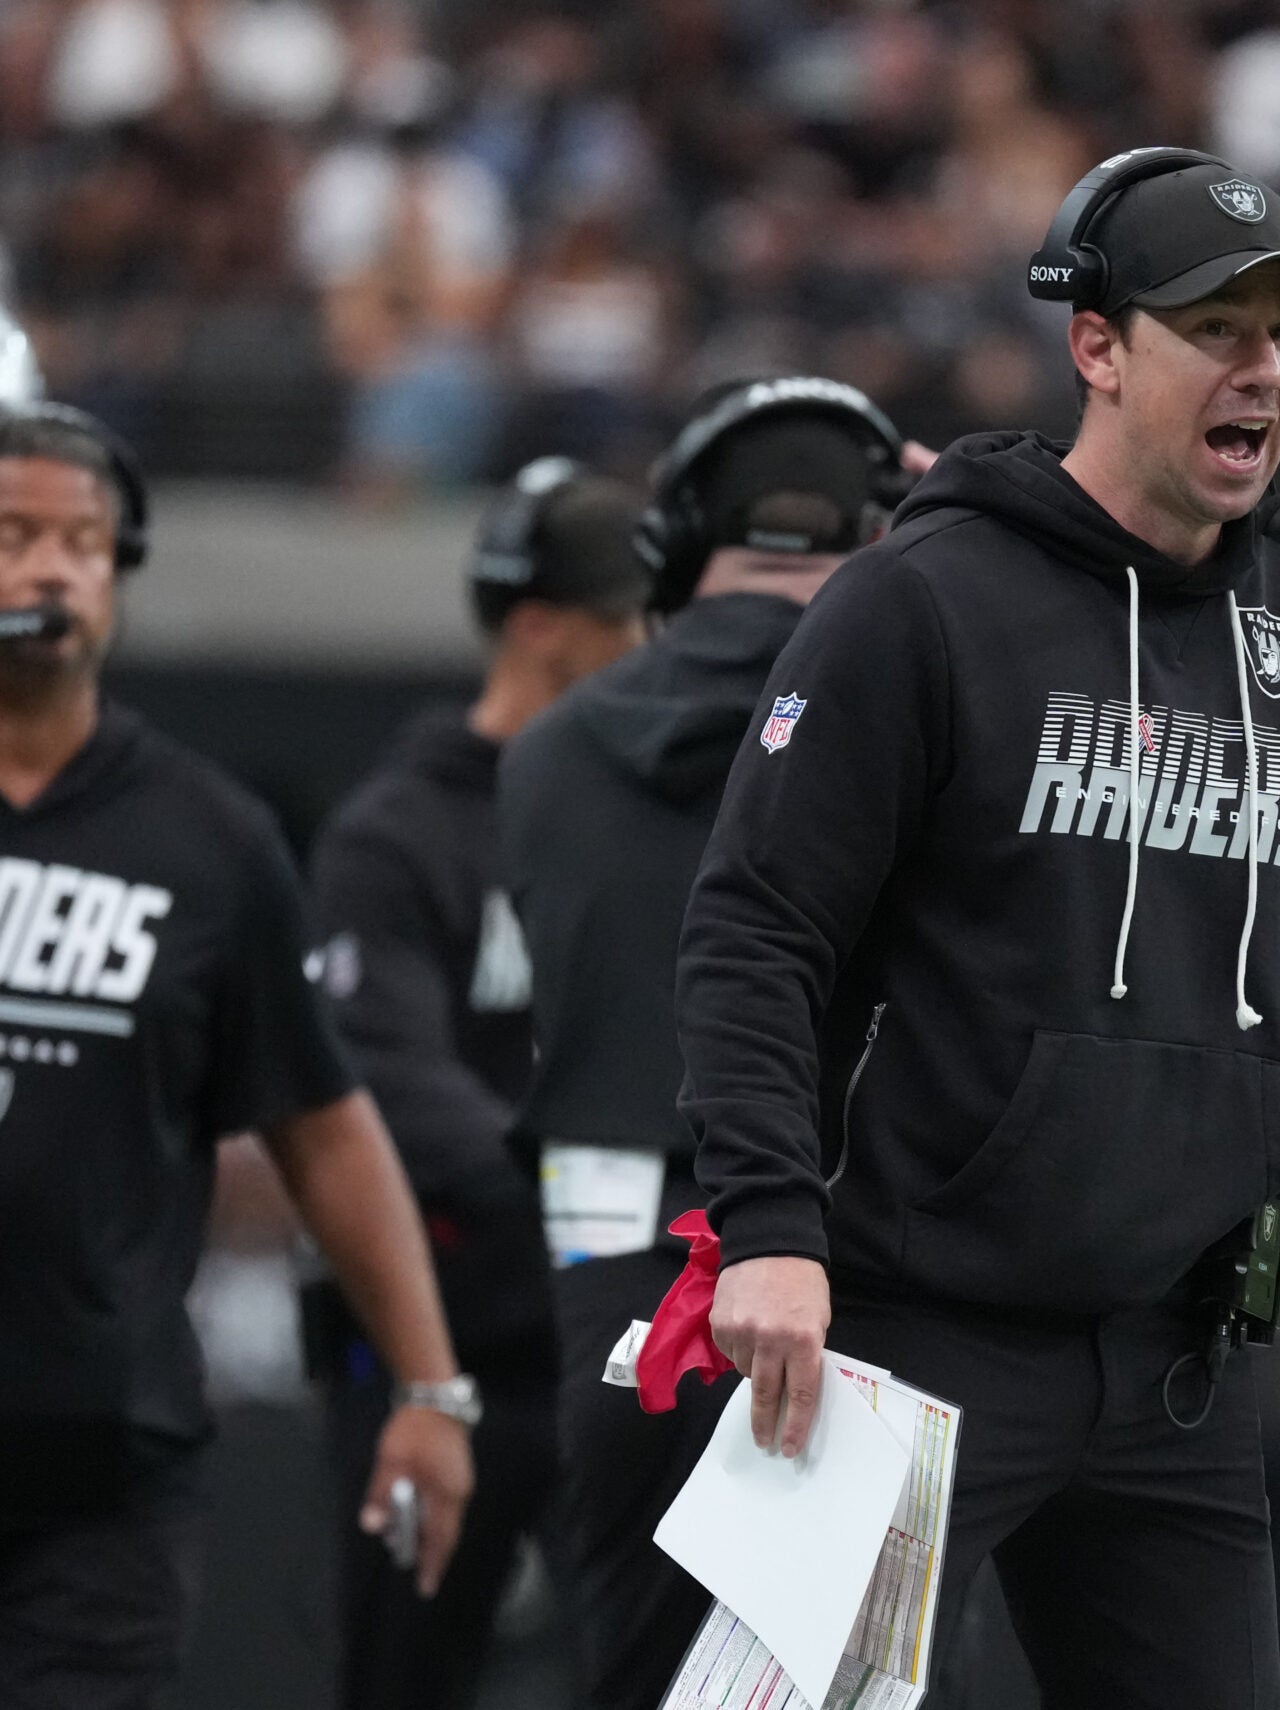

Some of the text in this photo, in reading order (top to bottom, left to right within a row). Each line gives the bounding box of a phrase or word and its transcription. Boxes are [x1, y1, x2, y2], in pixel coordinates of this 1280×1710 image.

[1030, 265, 1074, 282] SONY
[764, 717, 792, 744] NFL
[1056, 786, 1241, 824] ENGINEERED
